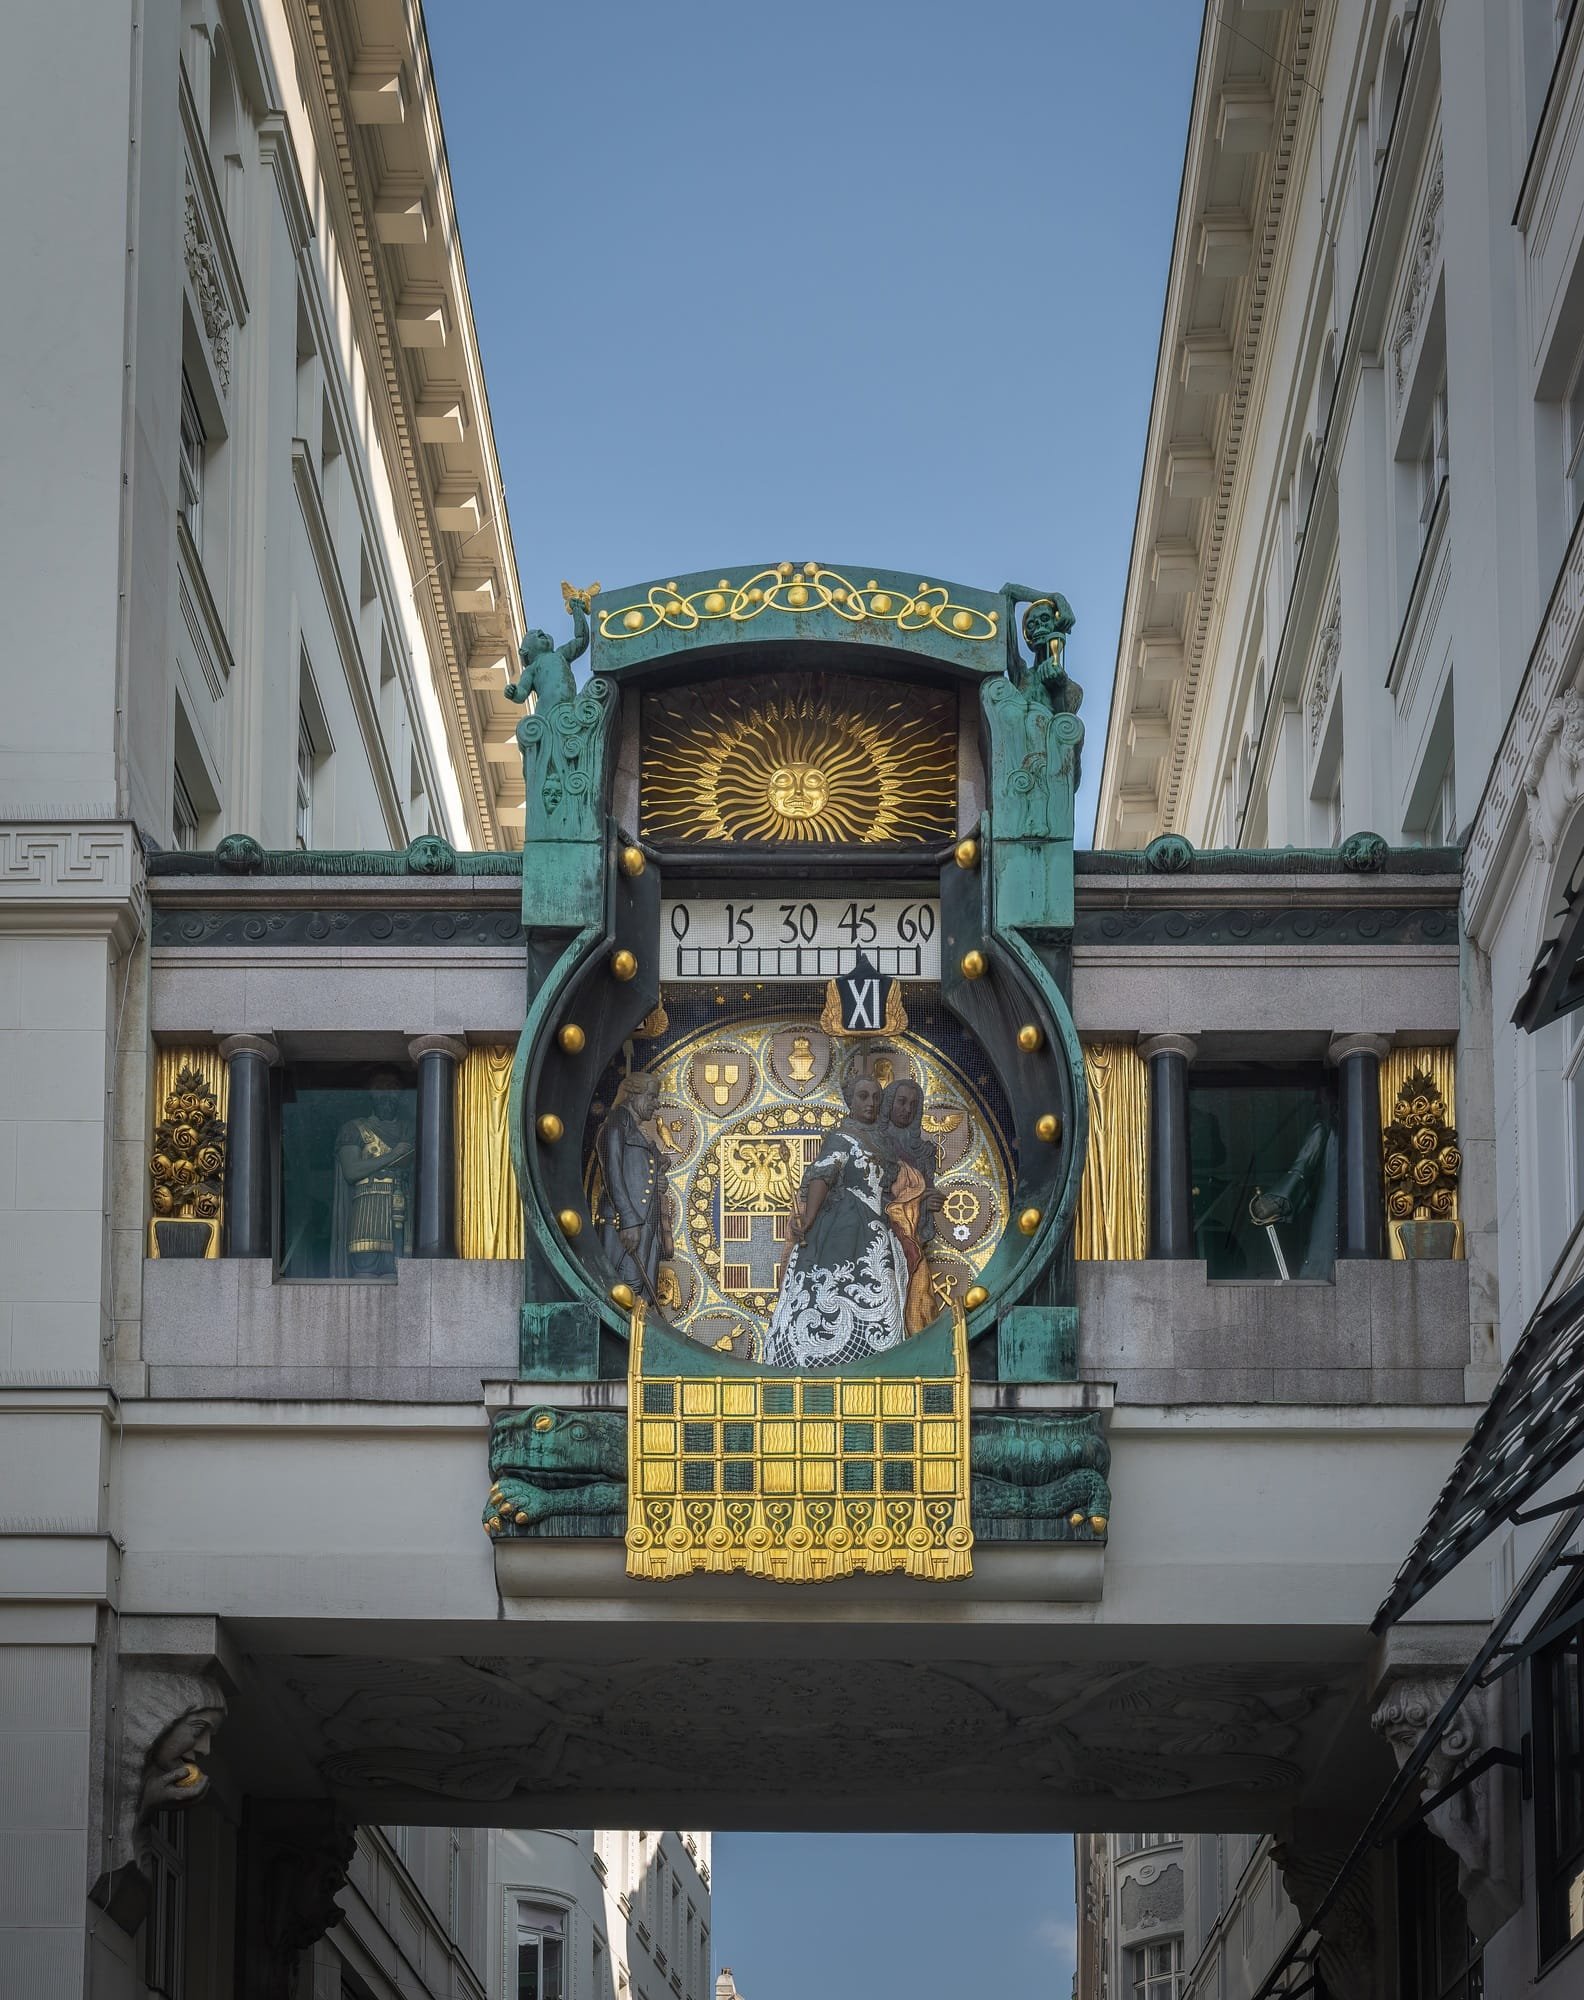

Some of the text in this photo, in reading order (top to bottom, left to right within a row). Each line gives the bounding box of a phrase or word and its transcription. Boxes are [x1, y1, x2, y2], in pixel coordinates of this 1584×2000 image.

[671, 903, 934, 944] 0 15 30 45 60
[848, 979, 880, 1028] XI
